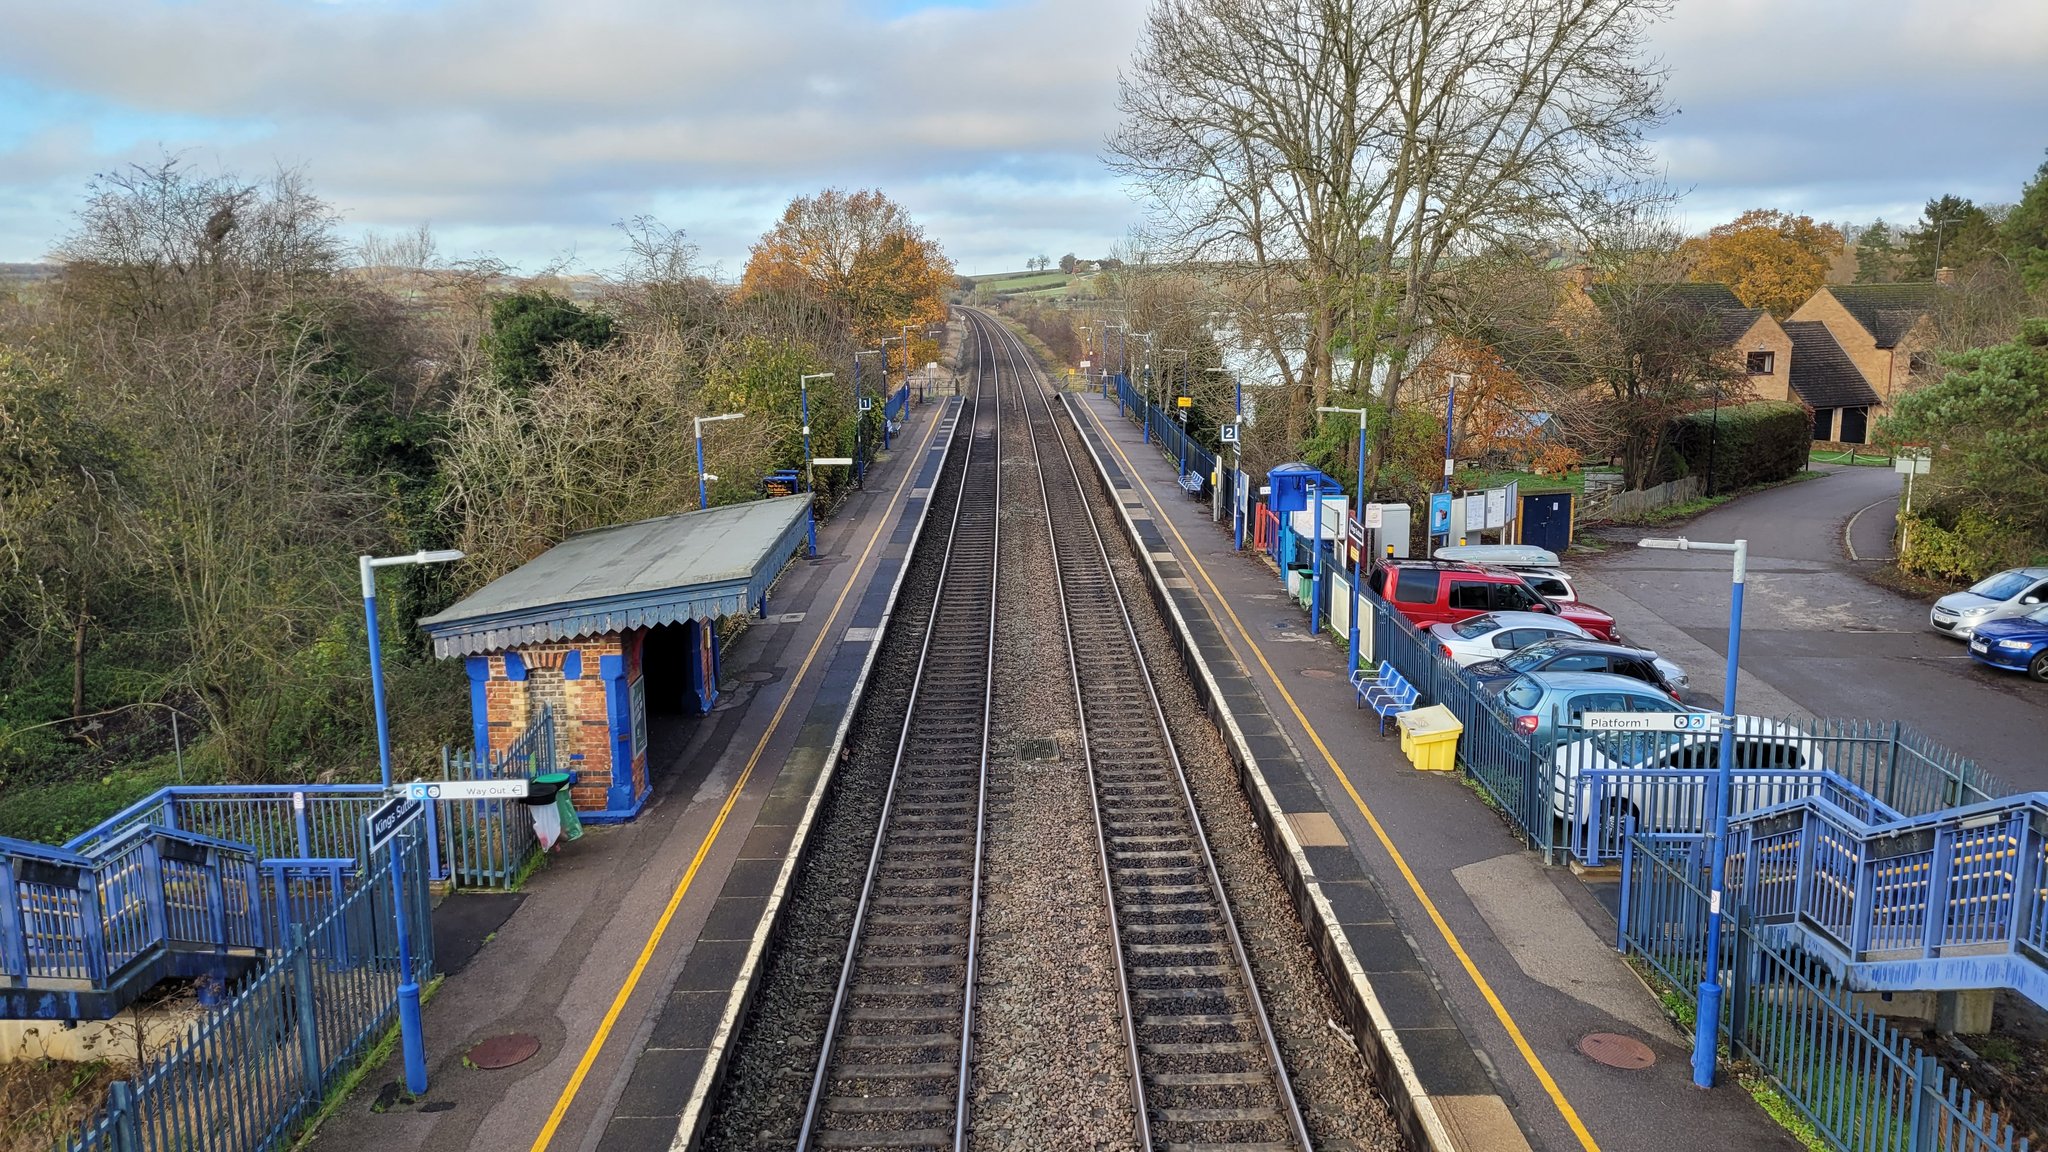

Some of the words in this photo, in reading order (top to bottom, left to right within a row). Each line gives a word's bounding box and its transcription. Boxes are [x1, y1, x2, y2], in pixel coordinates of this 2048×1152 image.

[1226, 428, 1234, 438] 2
[1591, 718, 1641, 728] Platform
[1645, 718, 1649, 727] 1
[466, 788, 487, 796] Way
[490, 787, 506, 795] Out
[376, 812, 396, 835] Kings
